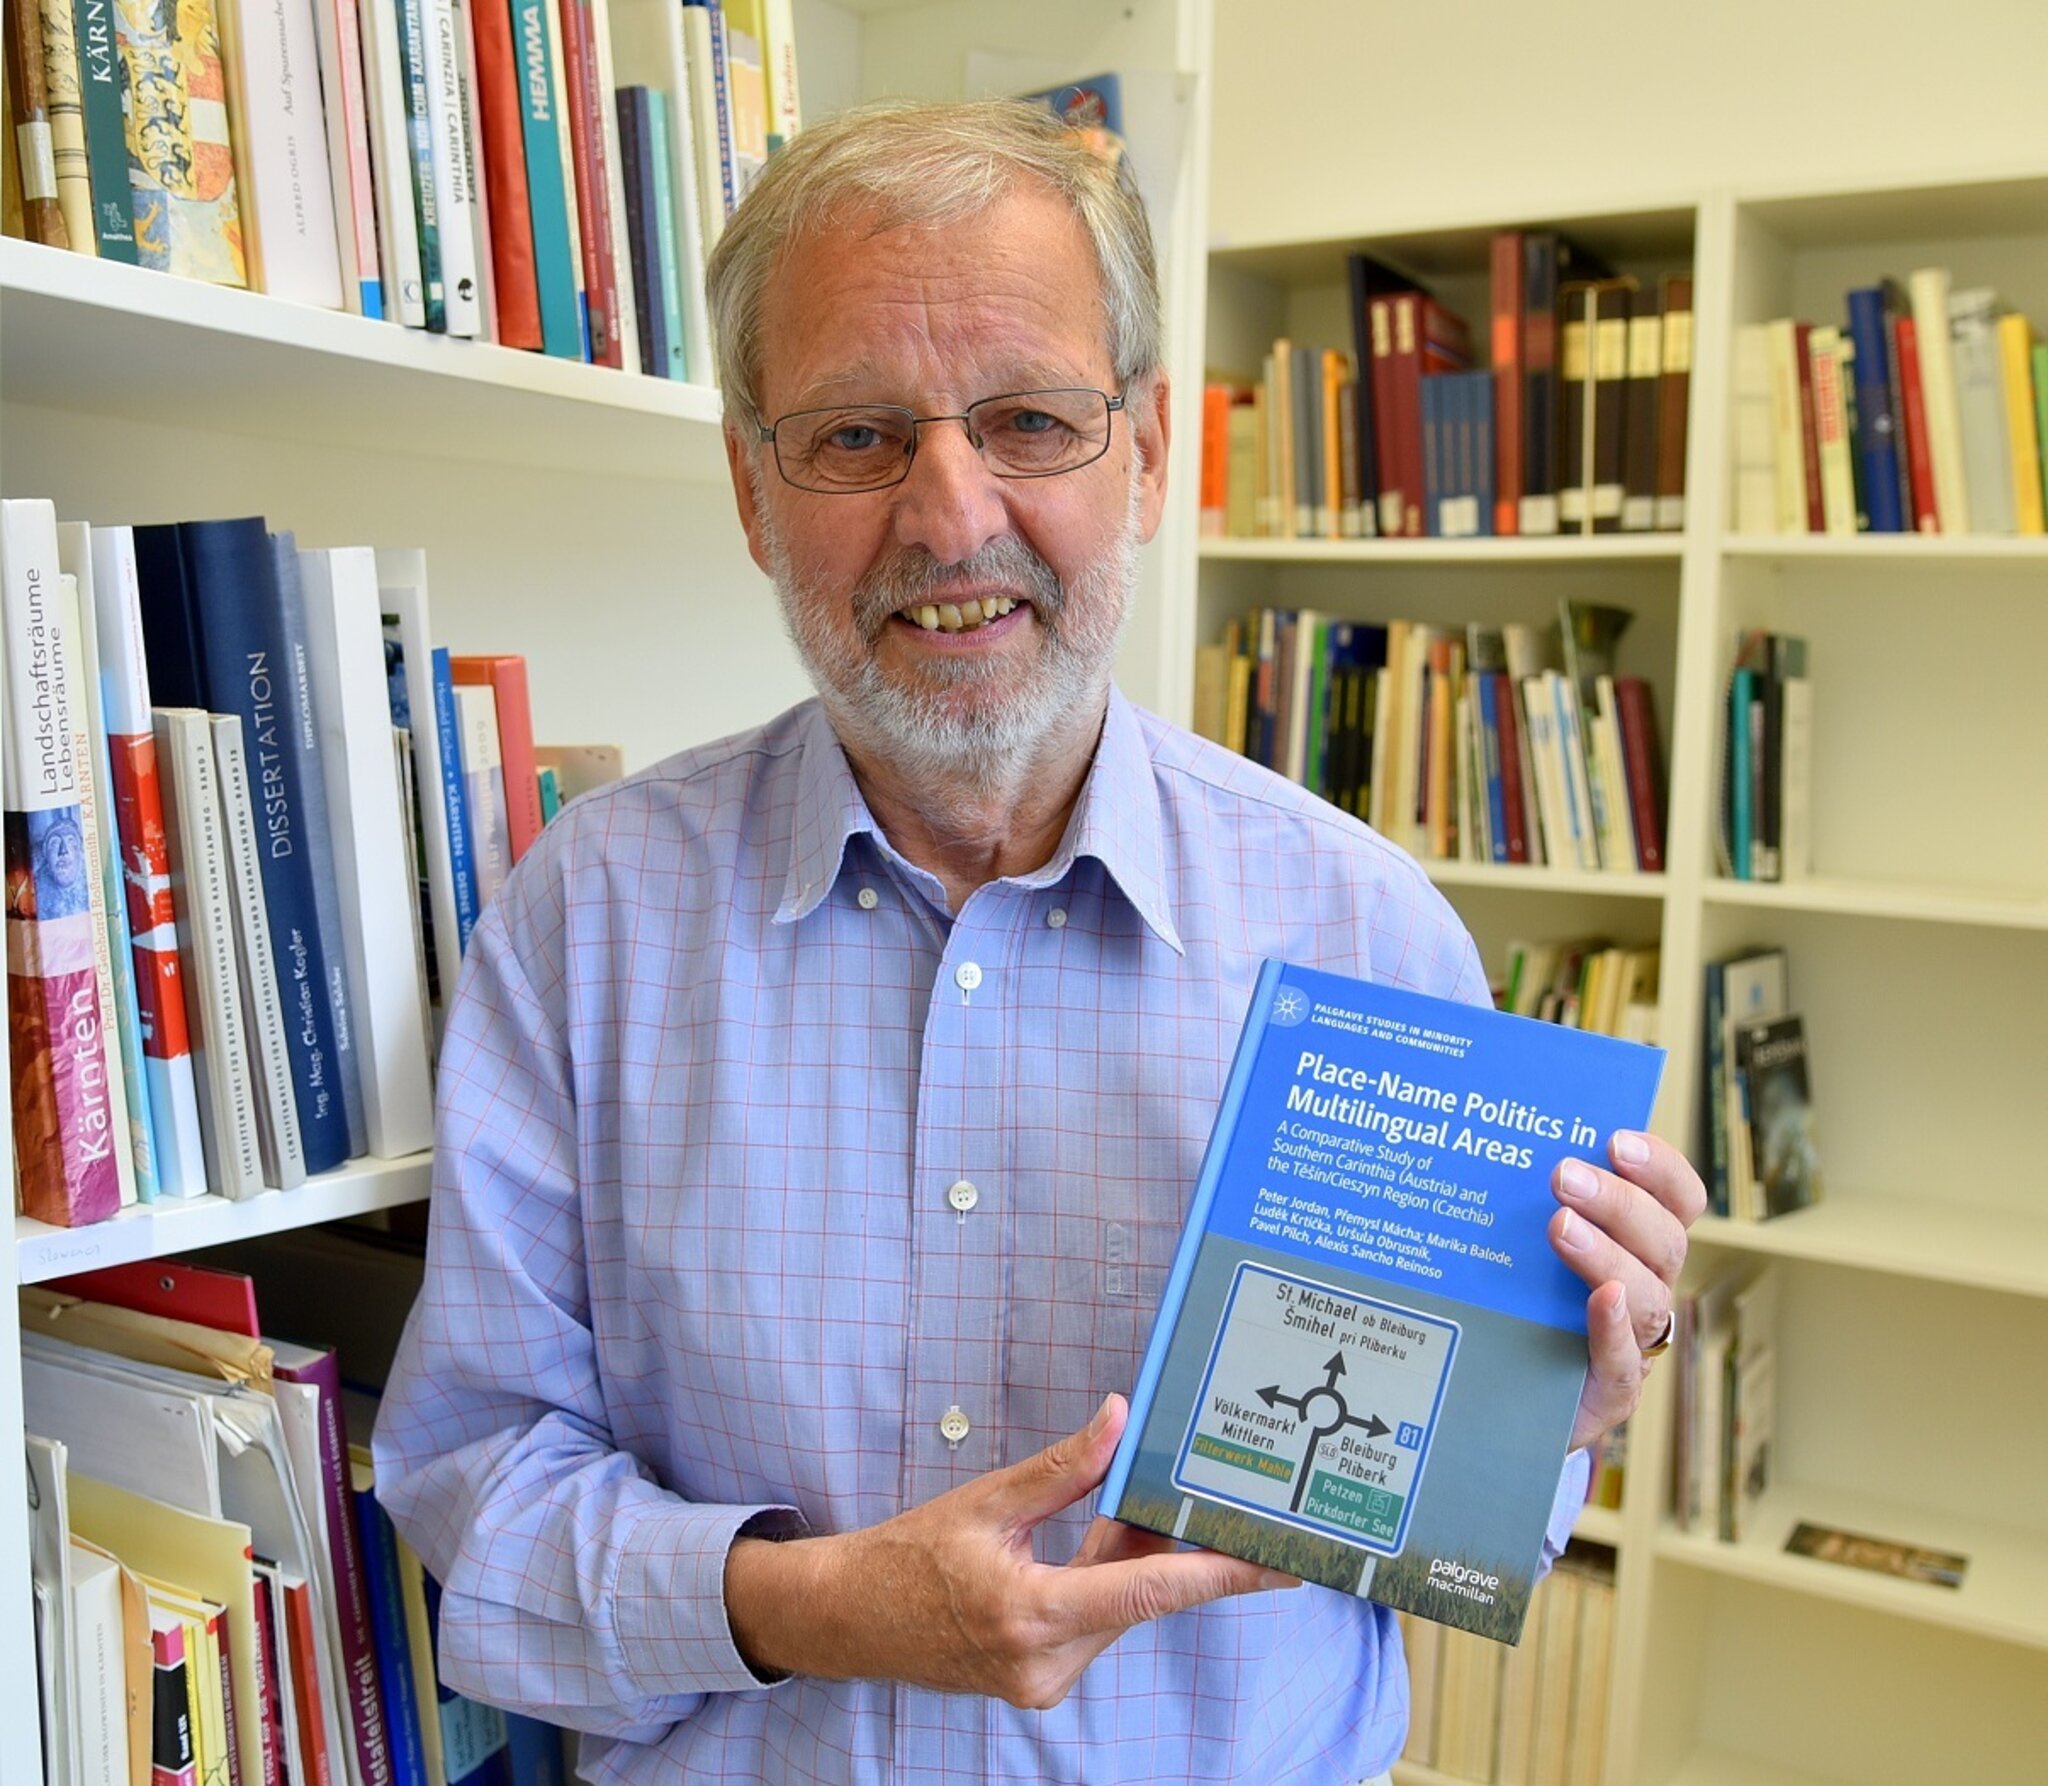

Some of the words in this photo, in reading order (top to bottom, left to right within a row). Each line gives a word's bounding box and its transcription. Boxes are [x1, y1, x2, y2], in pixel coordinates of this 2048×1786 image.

[438, 17, 455, 97] CARINZIA
[522, 6, 550, 121] HEMMA
[281, 90, 294, 116] Auf
[412, 84, 431, 150] NORICUM
[287, 136, 300, 178] OGRIS
[446, 112, 464, 204] CARINTHIA
[292, 183, 307, 236] ALFRED
[420, 162, 437, 227] KREUZER
[27, 567, 59, 795] Landschaftsräume
[49, 626, 74, 791] Lebensräume
[294, 642, 315, 750] DIPLOMARBEIT
[75, 732, 94, 820] KÄRNTEN
[198, 757, 209, 791] BAND
[231, 766, 242, 799] BAND
[247, 651, 292, 860] DISSERTATION
[85, 831, 103, 908] Roßmanith
[202, 806, 219, 900] RAUMPLANUNG
[238, 810, 256, 901] RAUMPLANUNG
[447, 784, 465, 856] KÄRNTEN
[456, 871, 471, 915] DEINE
[92, 911, 110, 976] Gebhard
[213, 906, 223, 932] UND
[250, 905, 261, 930] UND
[288, 927, 307, 980] Kogler
[99, 978, 112, 998] Dr.
[217, 936, 237, 1046] RAUMFORSCHUNG
[254, 933, 276, 1036] RAUMFORSCHUNG
[299, 981, 317, 1046] Christian
[101, 1002, 115, 1031] Prof.
[1311, 1015, 1369, 1035] LANGUAGES
[1371, 1028, 1392, 1041] AND
[1395, 1034, 1465, 1058] COMMUNITIES
[1314, 1002, 1364, 1023] PALGRAVE
[1366, 1015, 1406, 1033] STUDIES
[1409, 1026, 1420, 1036] IN
[1422, 1028, 1473, 1048] MINORITY
[72, 986, 110, 1163] Kärnten
[306, 1048, 324, 1087] Mag.
[233, 1078, 254, 1176] SCHRIFTENREIHE
[274, 1064, 297, 1160] SCHRIFTENREIHE
[313, 1090, 330, 1119] Ing.
[1286, 1084, 1450, 1149] Multilingual
[1452, 1127, 1534, 1169] Areas
[1296, 1051, 1457, 1114] Place-Name
[1463, 1092, 1565, 1141] Politics
[1570, 1116, 1597, 1149] in
[1272, 1138, 1334, 1165] Southern
[1336, 1153, 1395, 1182] Carinthia
[1398, 1168, 1457, 1199] (Austria)
[1459, 1187, 1488, 1205] and
[1277, 1120, 1288, 1135] A
[1290, 1123, 1375, 1156] Comparative
[1376, 1145, 1415, 1170] Study
[1416, 1155, 1434, 1171] of
[1267, 1156, 1289, 1174] the
[1382, 1185, 1429, 1211] Region
[1432, 1197, 1496, 1228] (Czechia)
[1249, 1217, 1280, 1236] Pavel
[1281, 1225, 1313, 1246] Pilch,
[1314, 1235, 1350, 1254] Alexis
[1351, 1244, 1393, 1266] Sancho
[1395, 1256, 1443, 1280] Reinoso
[1254, 1201, 1289, 1222] Luděk
[1336, 1223, 1375, 1246] Uršula
[1258, 1188, 1289, 1206] Peter
[1289, 1196, 1331, 1219] Jordan,
[1334, 1207, 1380, 1233] Přemysl
[1426, 1232, 1467, 1254] Marika
[1469, 1243, 1514, 1269] Balode,
[1276, 1282, 1296, 1306] St.
[1297, 1289, 1358, 1322] Michael
[1361, 1309, 1376, 1328] ob
[1379, 1316, 1426, 1345] Bleiburg
[1283, 1302, 1337, 1339] Šmihel
[1338, 1330, 1356, 1346] pri
[1359, 1334, 1407, 1361] Pliberku
[1213, 1397, 1297, 1437] Völkermarkt
[1220, 1421, 1275, 1450] Mittlern
[1399, 1425, 1421, 1448] 81
[1193, 1436, 1254, 1467] Filterwerk
[1338, 1457, 1389, 1487] Pliberk
[1340, 1436, 1397, 1471] Bleiburg
[1306, 1496, 1368, 1530] Pirkdorfer
[1371, 1515, 1394, 1537] See
[1322, 1479, 1364, 1504] Petzen
[1426, 1576, 1494, 1605] macmillan
[1429, 1558, 1499, 1590] palgrave
[263, 1746, 276, 1785] STOLZ
